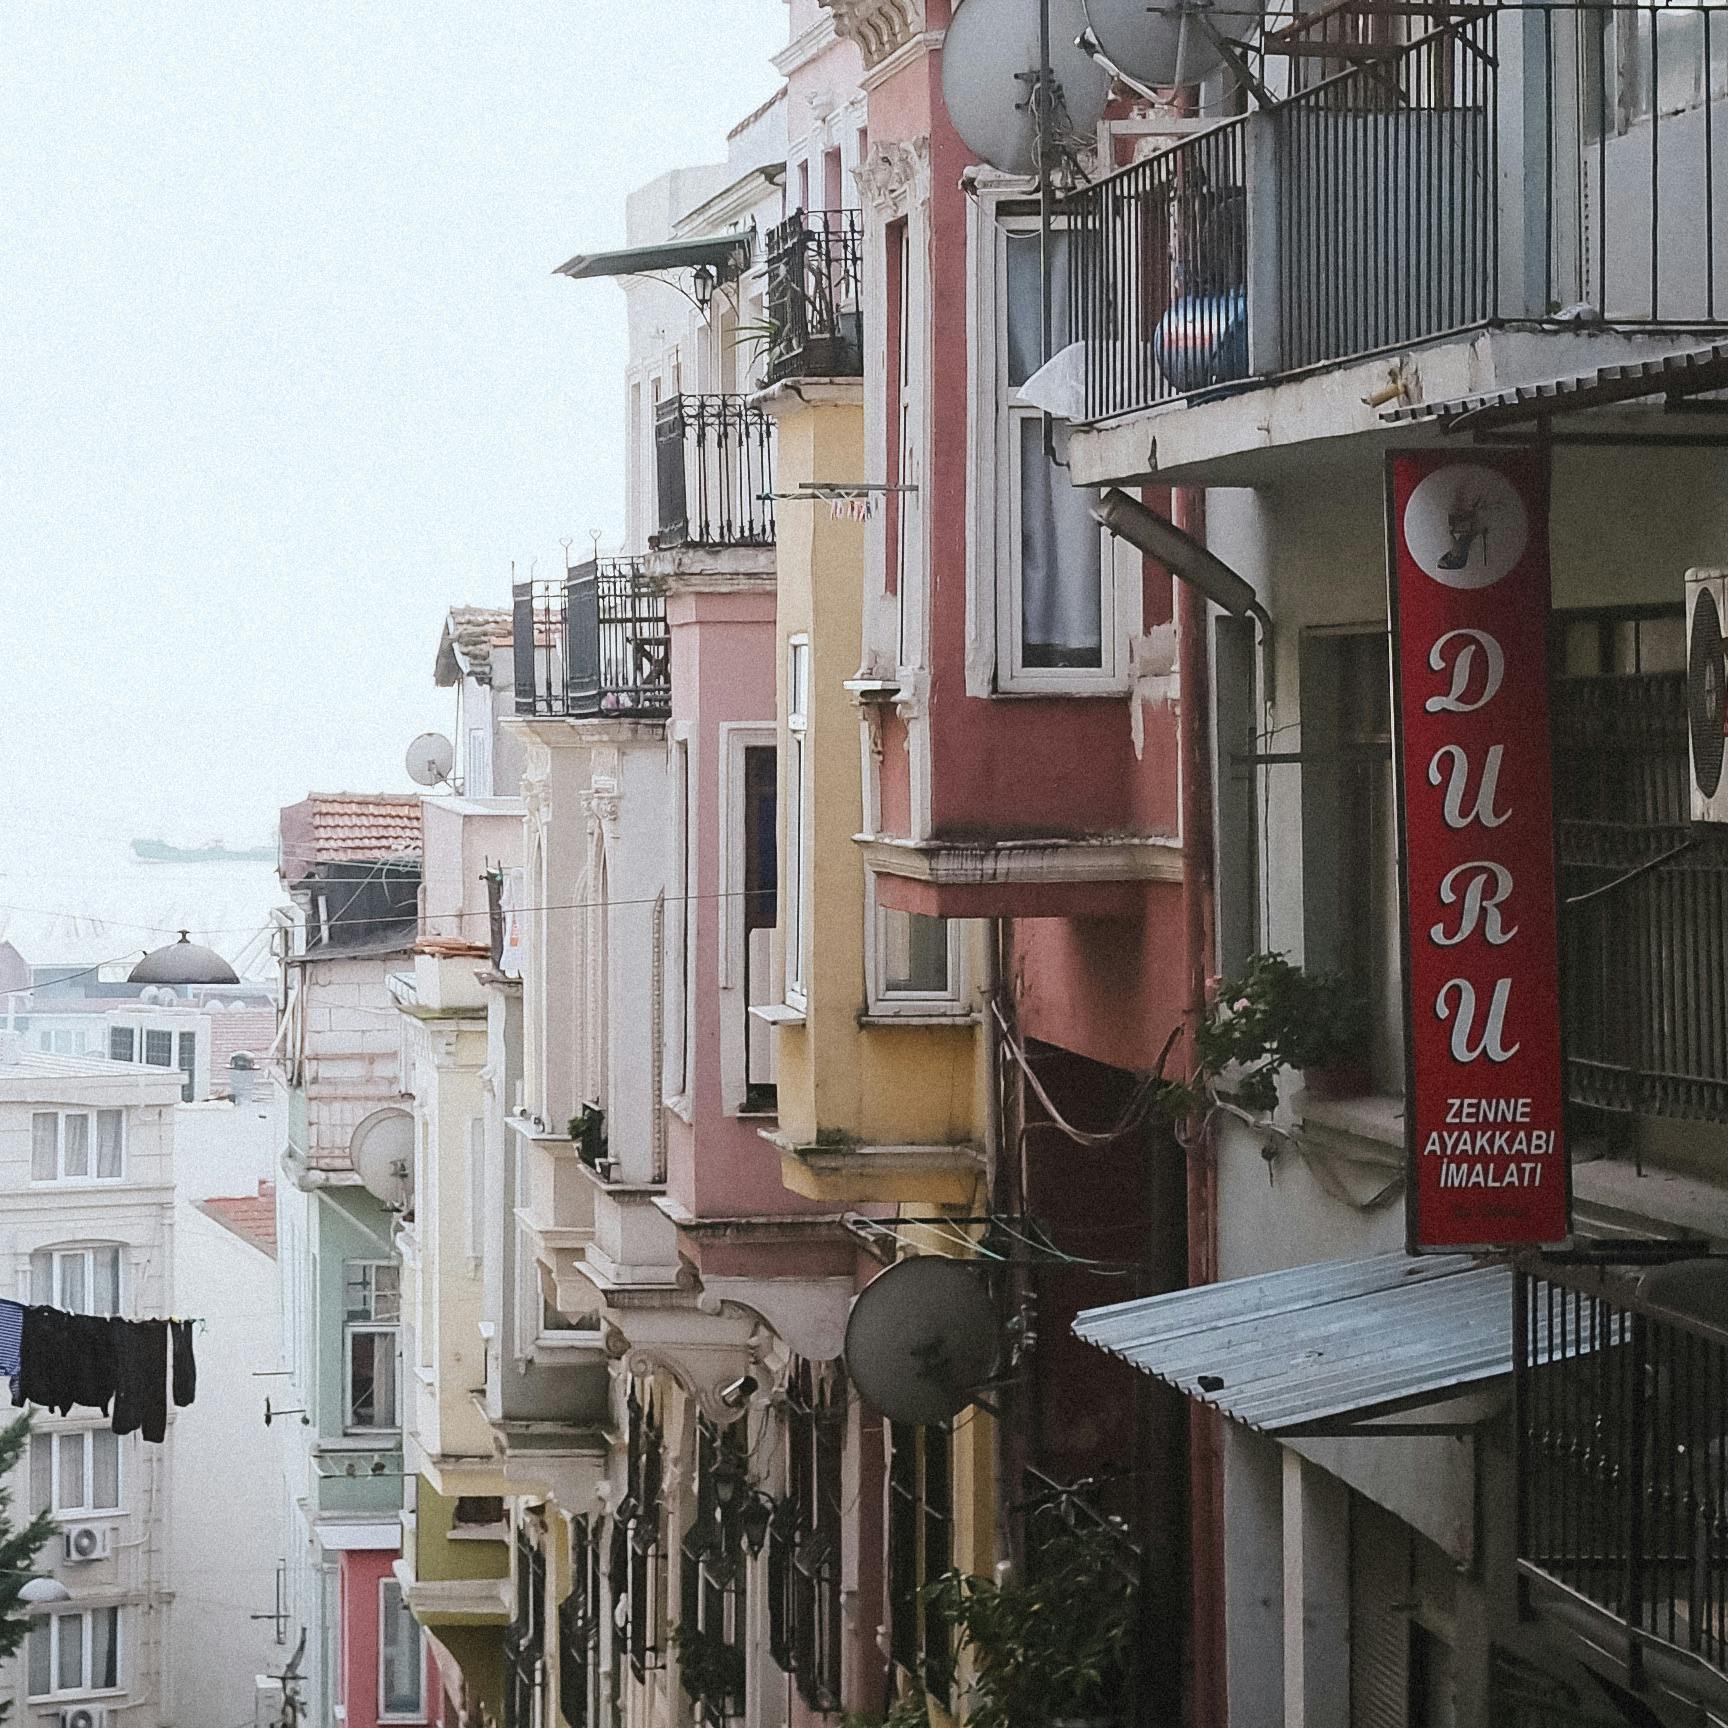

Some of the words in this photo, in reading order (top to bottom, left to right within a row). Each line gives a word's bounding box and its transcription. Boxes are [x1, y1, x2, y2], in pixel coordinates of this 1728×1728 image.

[1424, 628, 1521, 1063] DURU
[1445, 1098, 1533, 1123] ZENNE
[1424, 1130, 1556, 1156] AYAKKABI
[1439, 1158, 1542, 1188] İMALATI
